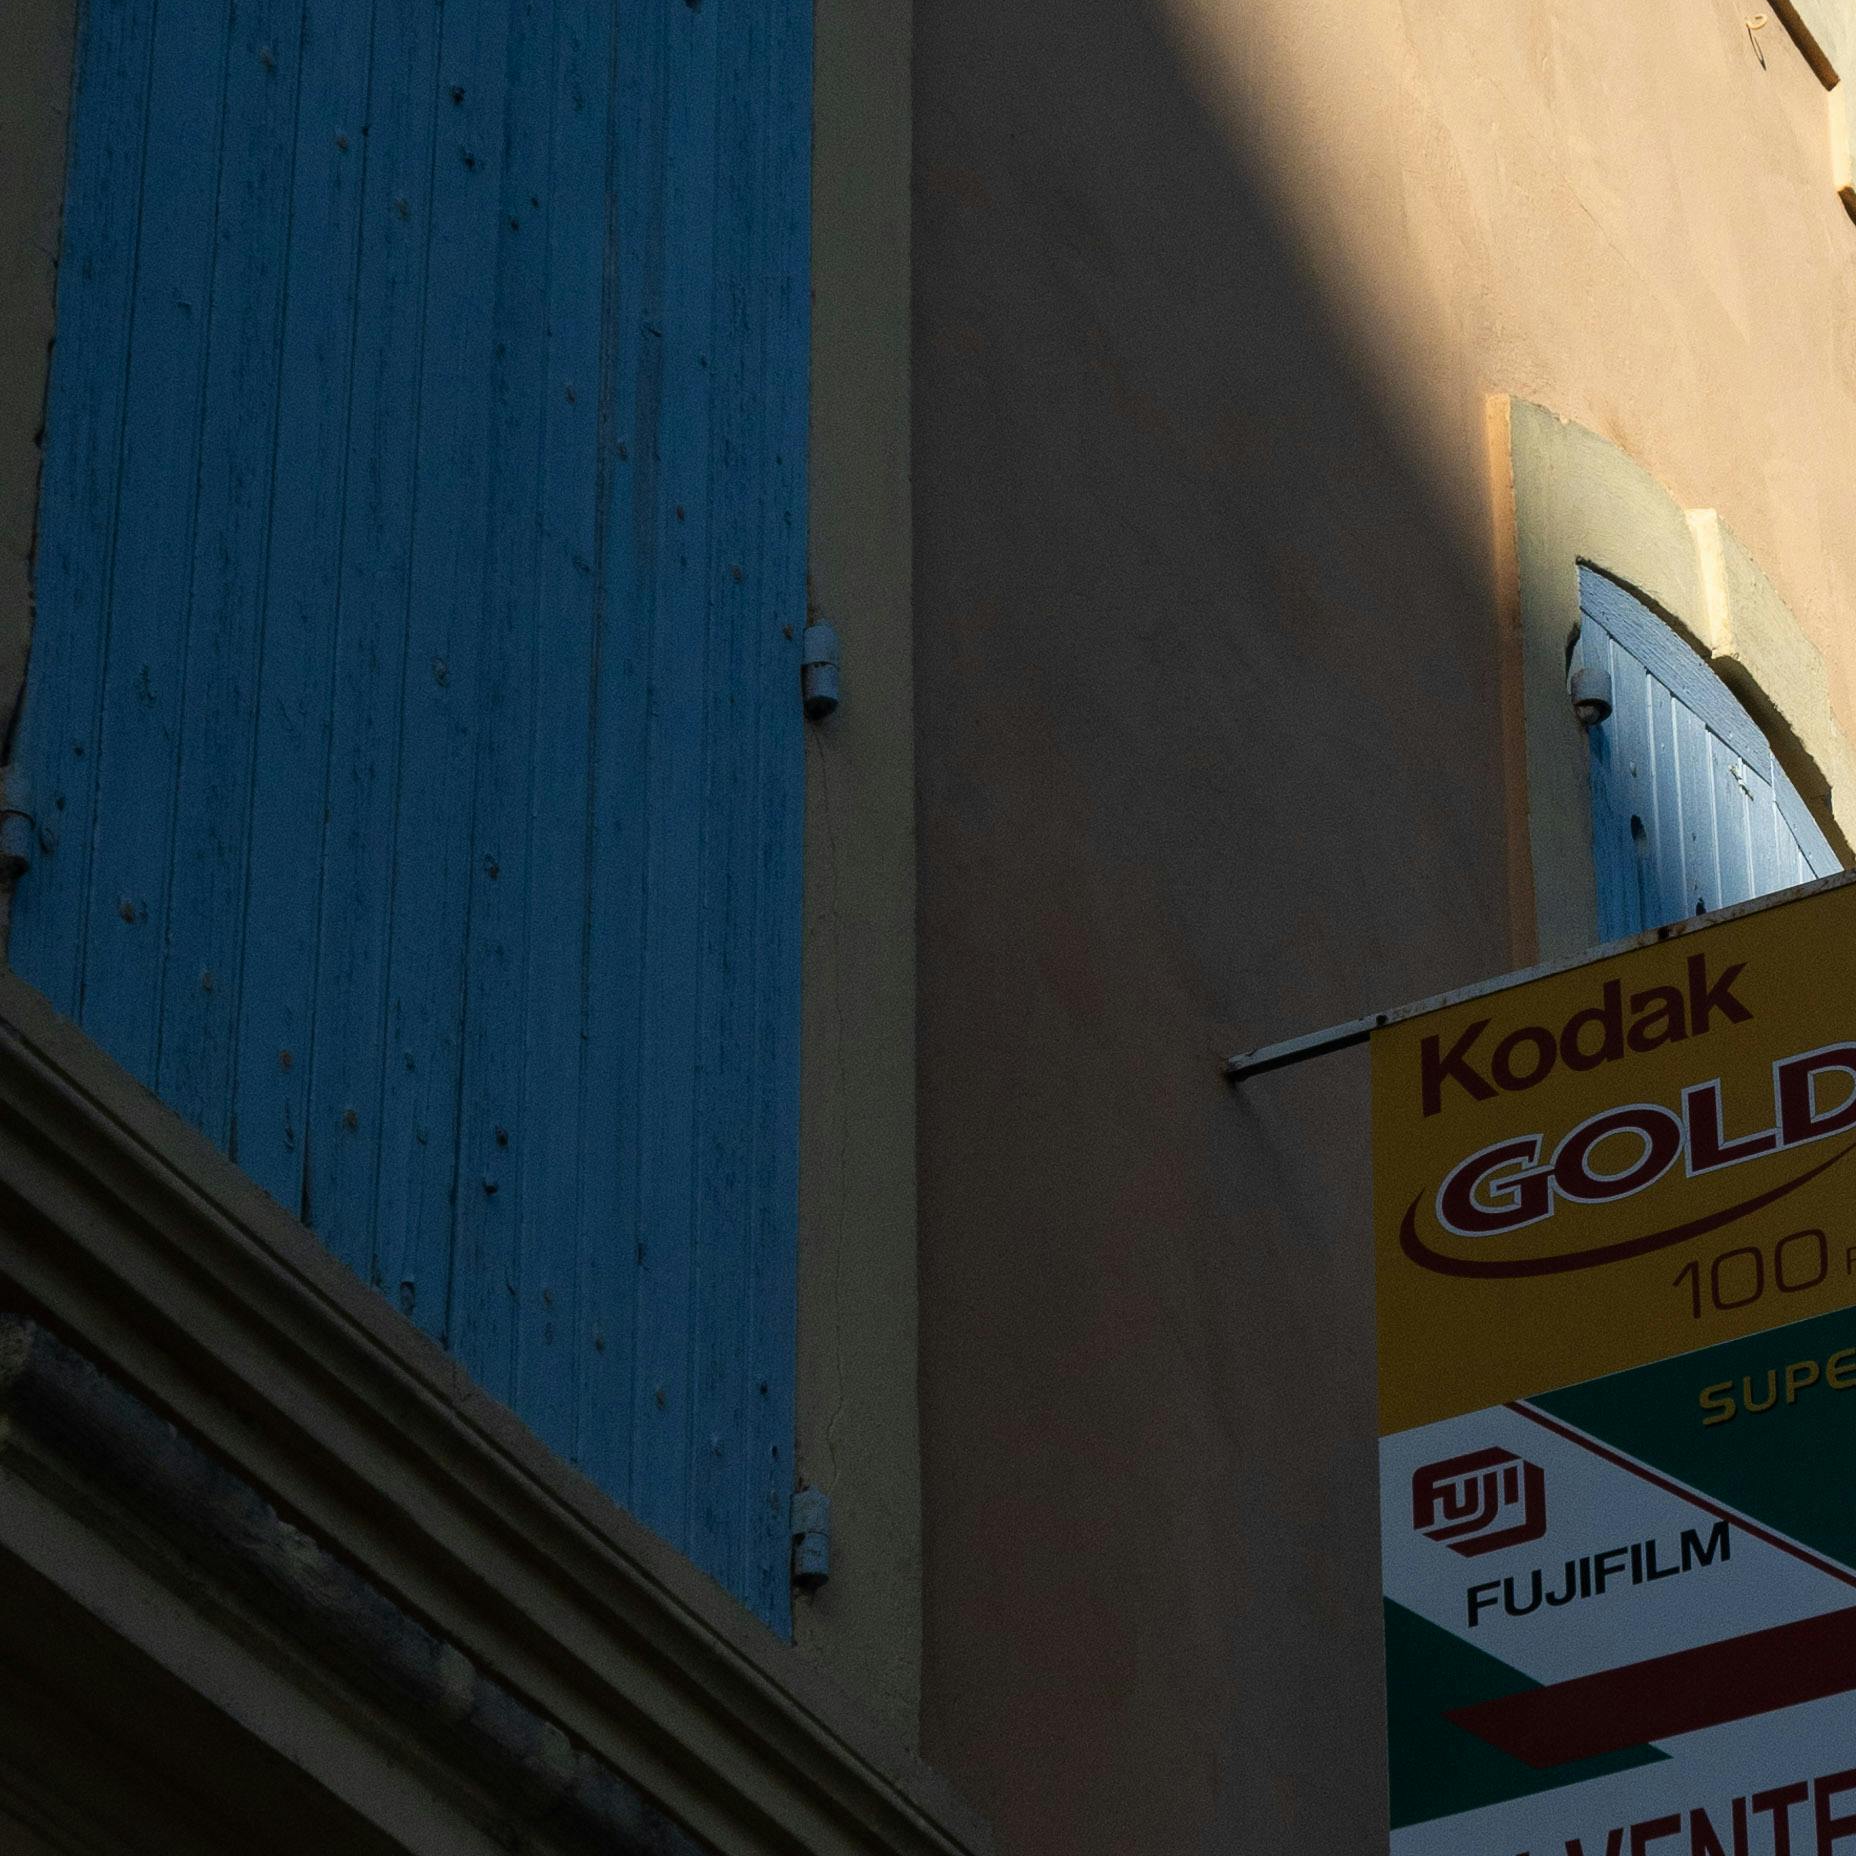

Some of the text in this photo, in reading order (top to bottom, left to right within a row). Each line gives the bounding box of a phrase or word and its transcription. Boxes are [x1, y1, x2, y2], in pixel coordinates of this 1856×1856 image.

[1420, 953, 1753, 1117] Kodak
[1673, 1228, 1828, 1319] 100
[1413, 1446, 1547, 1558] FUJI
[1466, 1520, 1731, 1628] FUJIFILM
